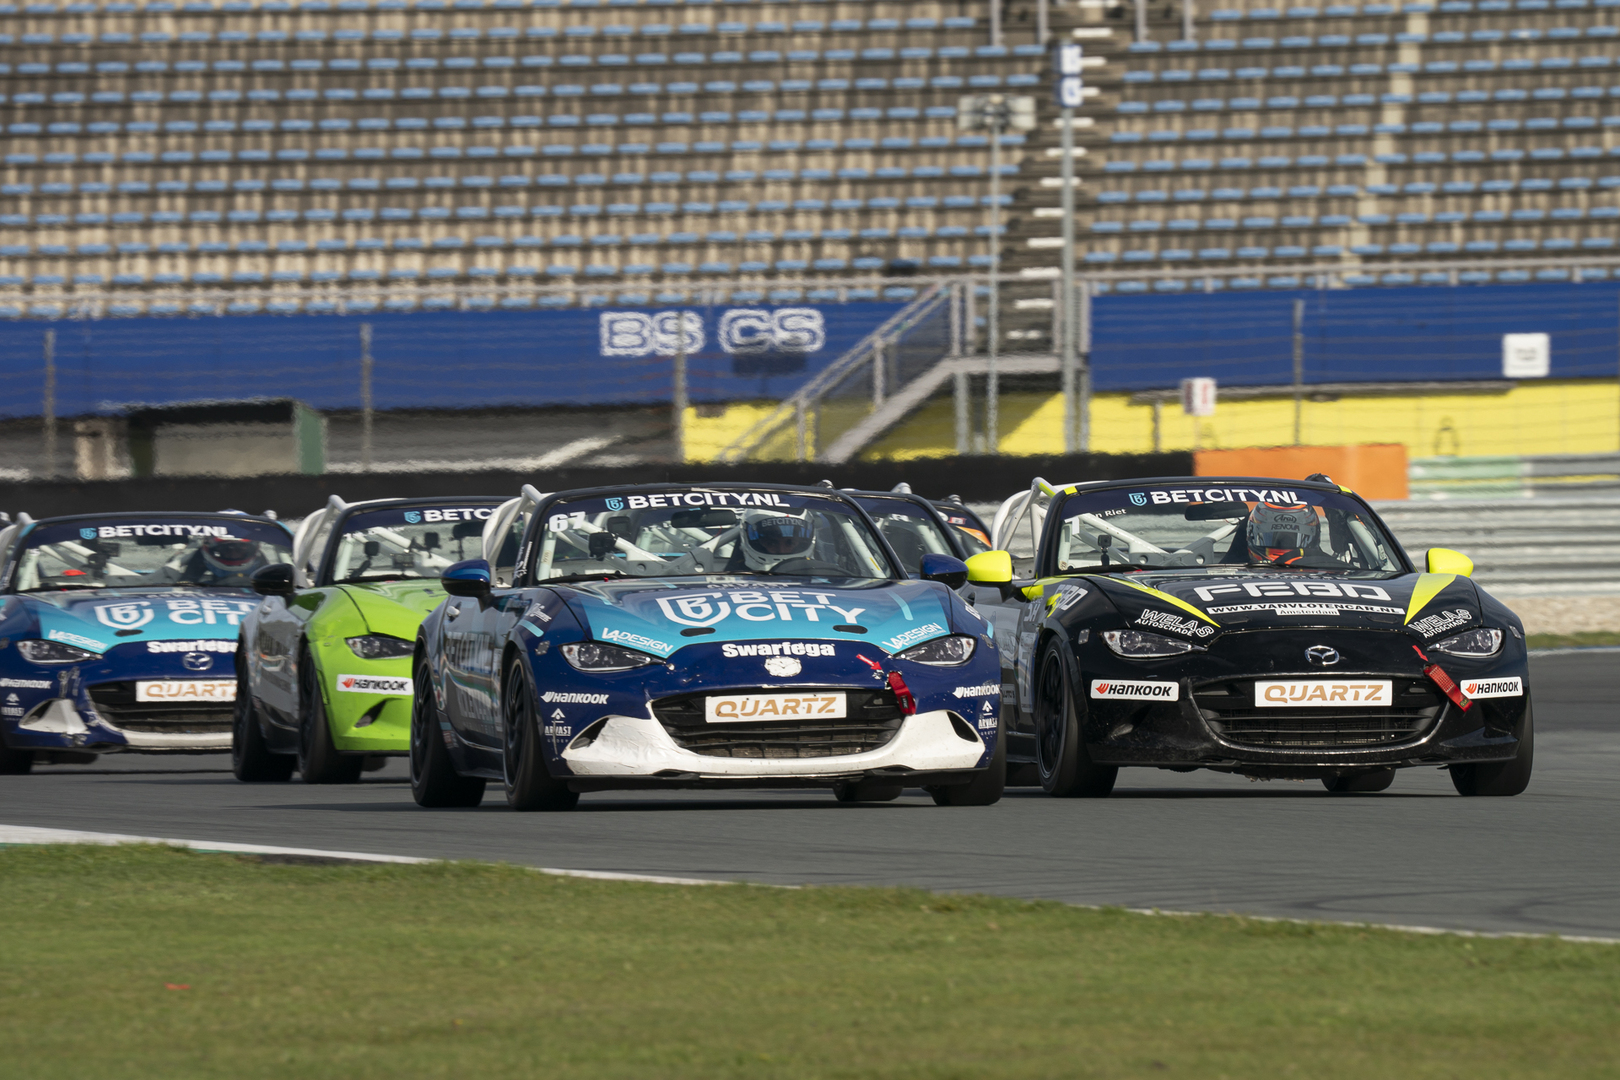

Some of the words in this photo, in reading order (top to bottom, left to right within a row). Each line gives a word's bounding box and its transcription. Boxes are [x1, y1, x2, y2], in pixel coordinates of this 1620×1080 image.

[628, 492, 791, 509] BETCITY.NL
[1150, 488, 1308, 506] BETCITY.NL
[549, 511, 586, 532] 67
[98, 524, 235, 539] BETCITY.NL
[166, 599, 256, 612] BET
[727, 591, 836, 605] BET
[735, 603, 866, 624] CITY
[1212, 602, 1402, 615] WWW.VANVLOTENCAR.NL
[1280, 608, 1338, 616] Amsterdam
[169, 610, 247, 625] CIT
[1141, 608, 1215, 638] WELAS
[1134, 618, 1195, 637] AUTOSCHADE
[1423, 619, 1468, 639] AUTOSCHADE
[722, 641, 836, 657] Swarfega
[146, 683, 237, 698] QUART
[1264, 684, 1384, 704] QUARTZ
[715, 696, 837, 719] QUARTZ
